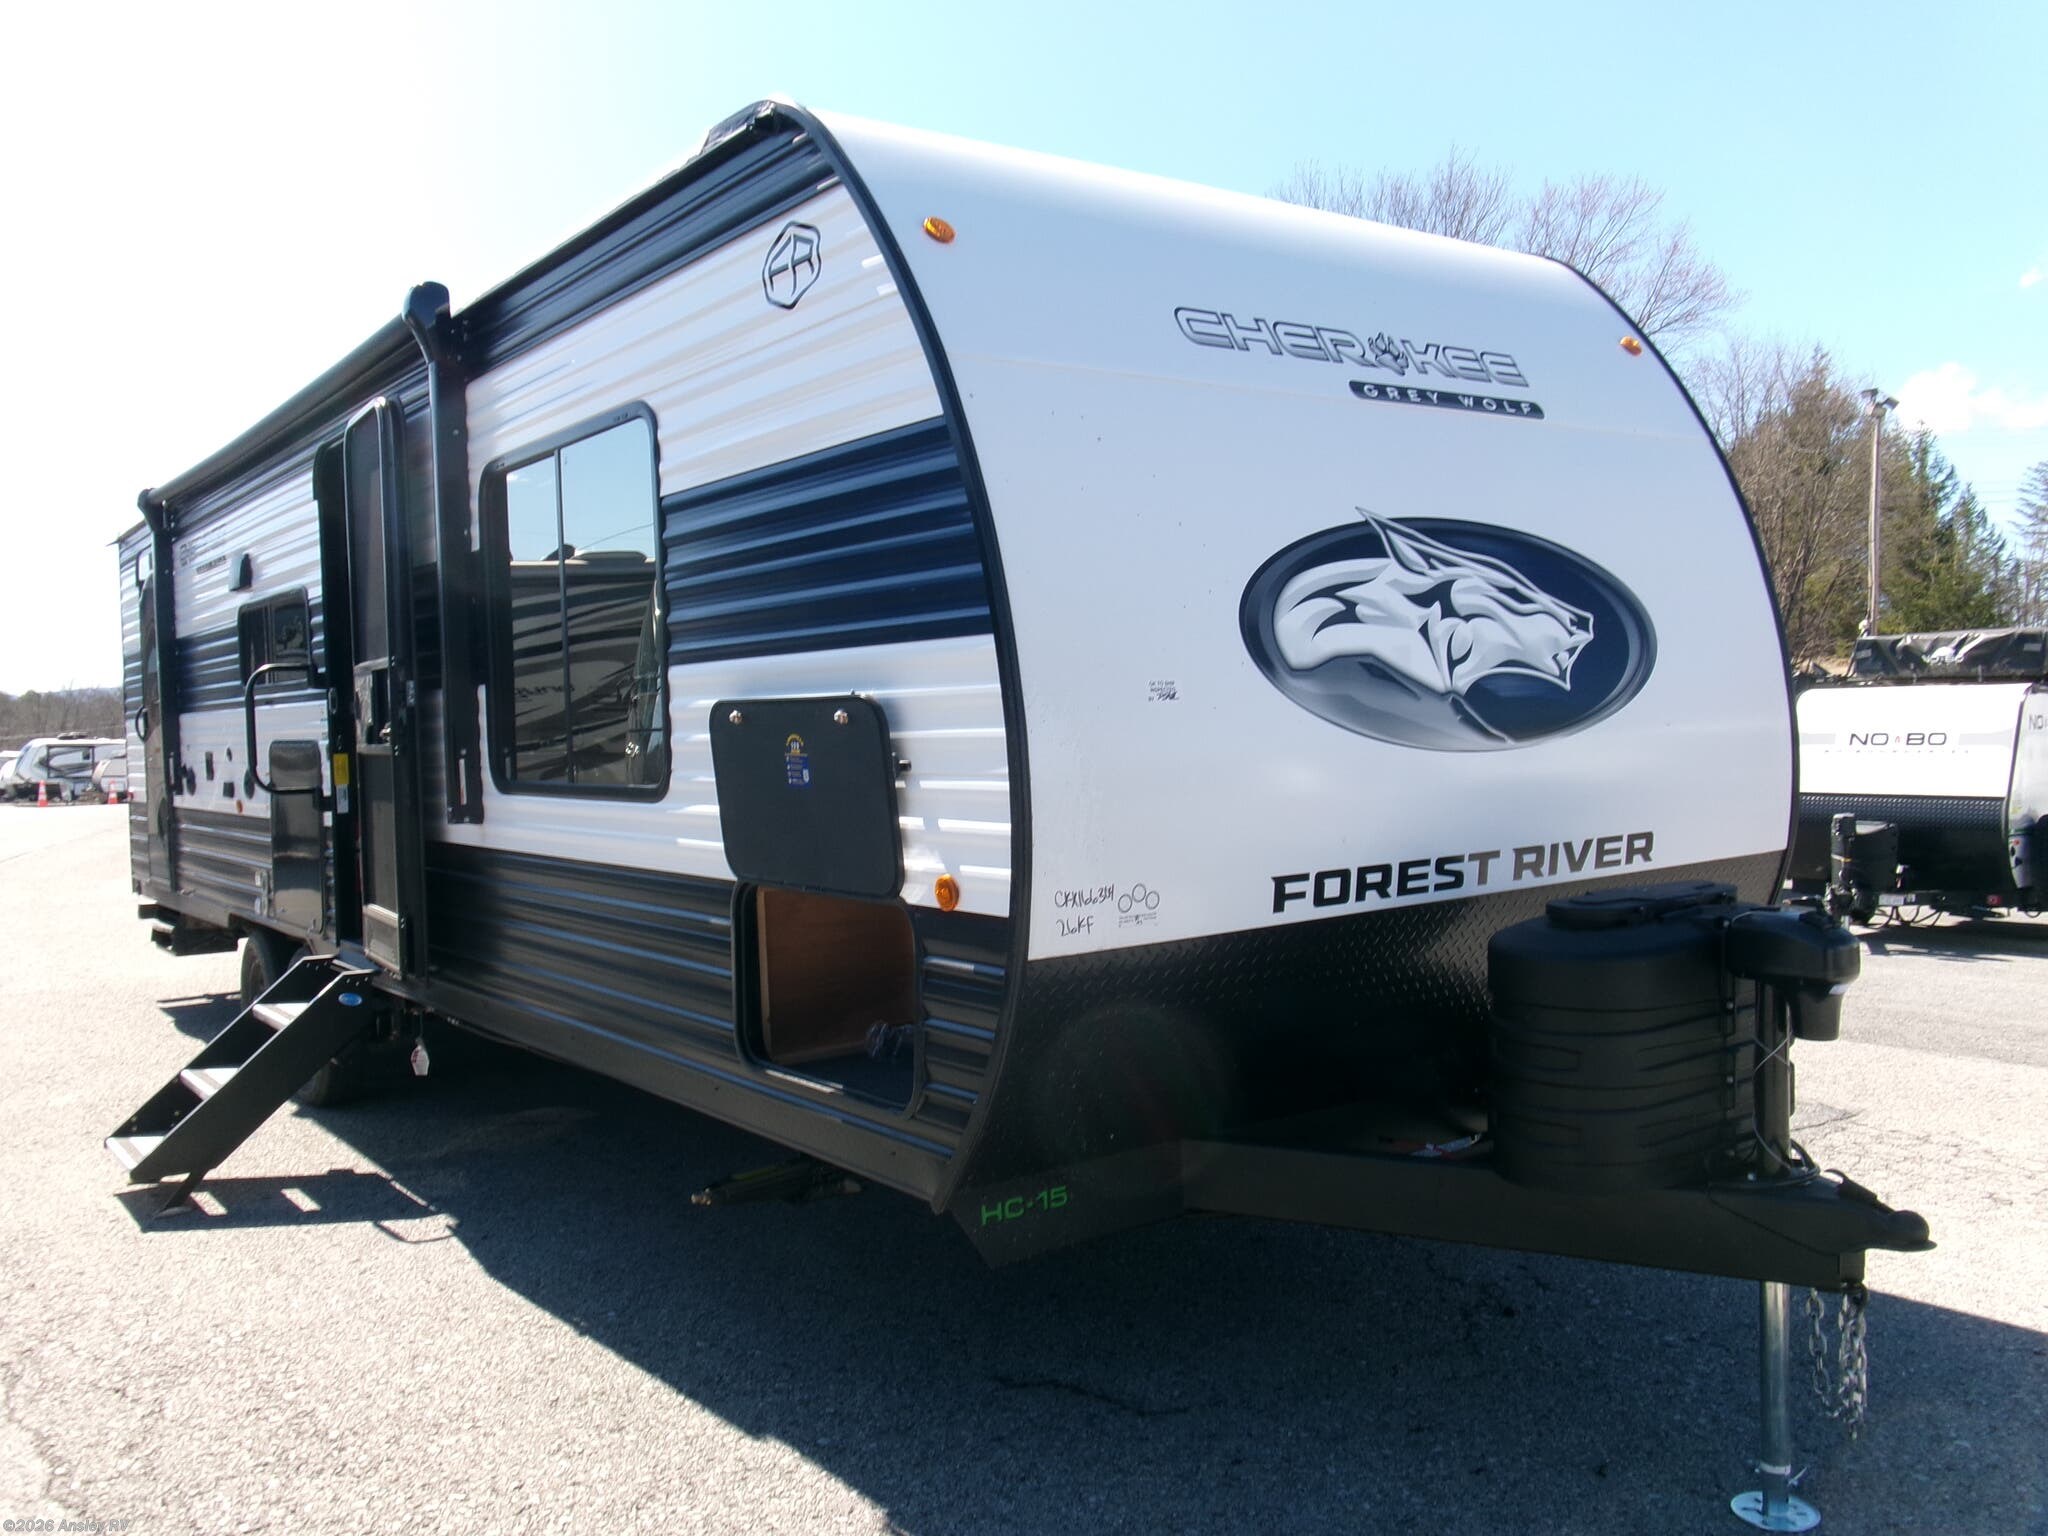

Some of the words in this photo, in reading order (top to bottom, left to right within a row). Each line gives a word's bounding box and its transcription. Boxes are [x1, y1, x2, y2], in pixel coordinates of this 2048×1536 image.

[1363, 383, 1440, 406] GREY
[1457, 394, 1536, 416] WOLF
[1271, 850, 1500, 914] FOREST
[1512, 831, 1654, 881] RIVER
[981, 1185, 1067, 1226] HC-15
